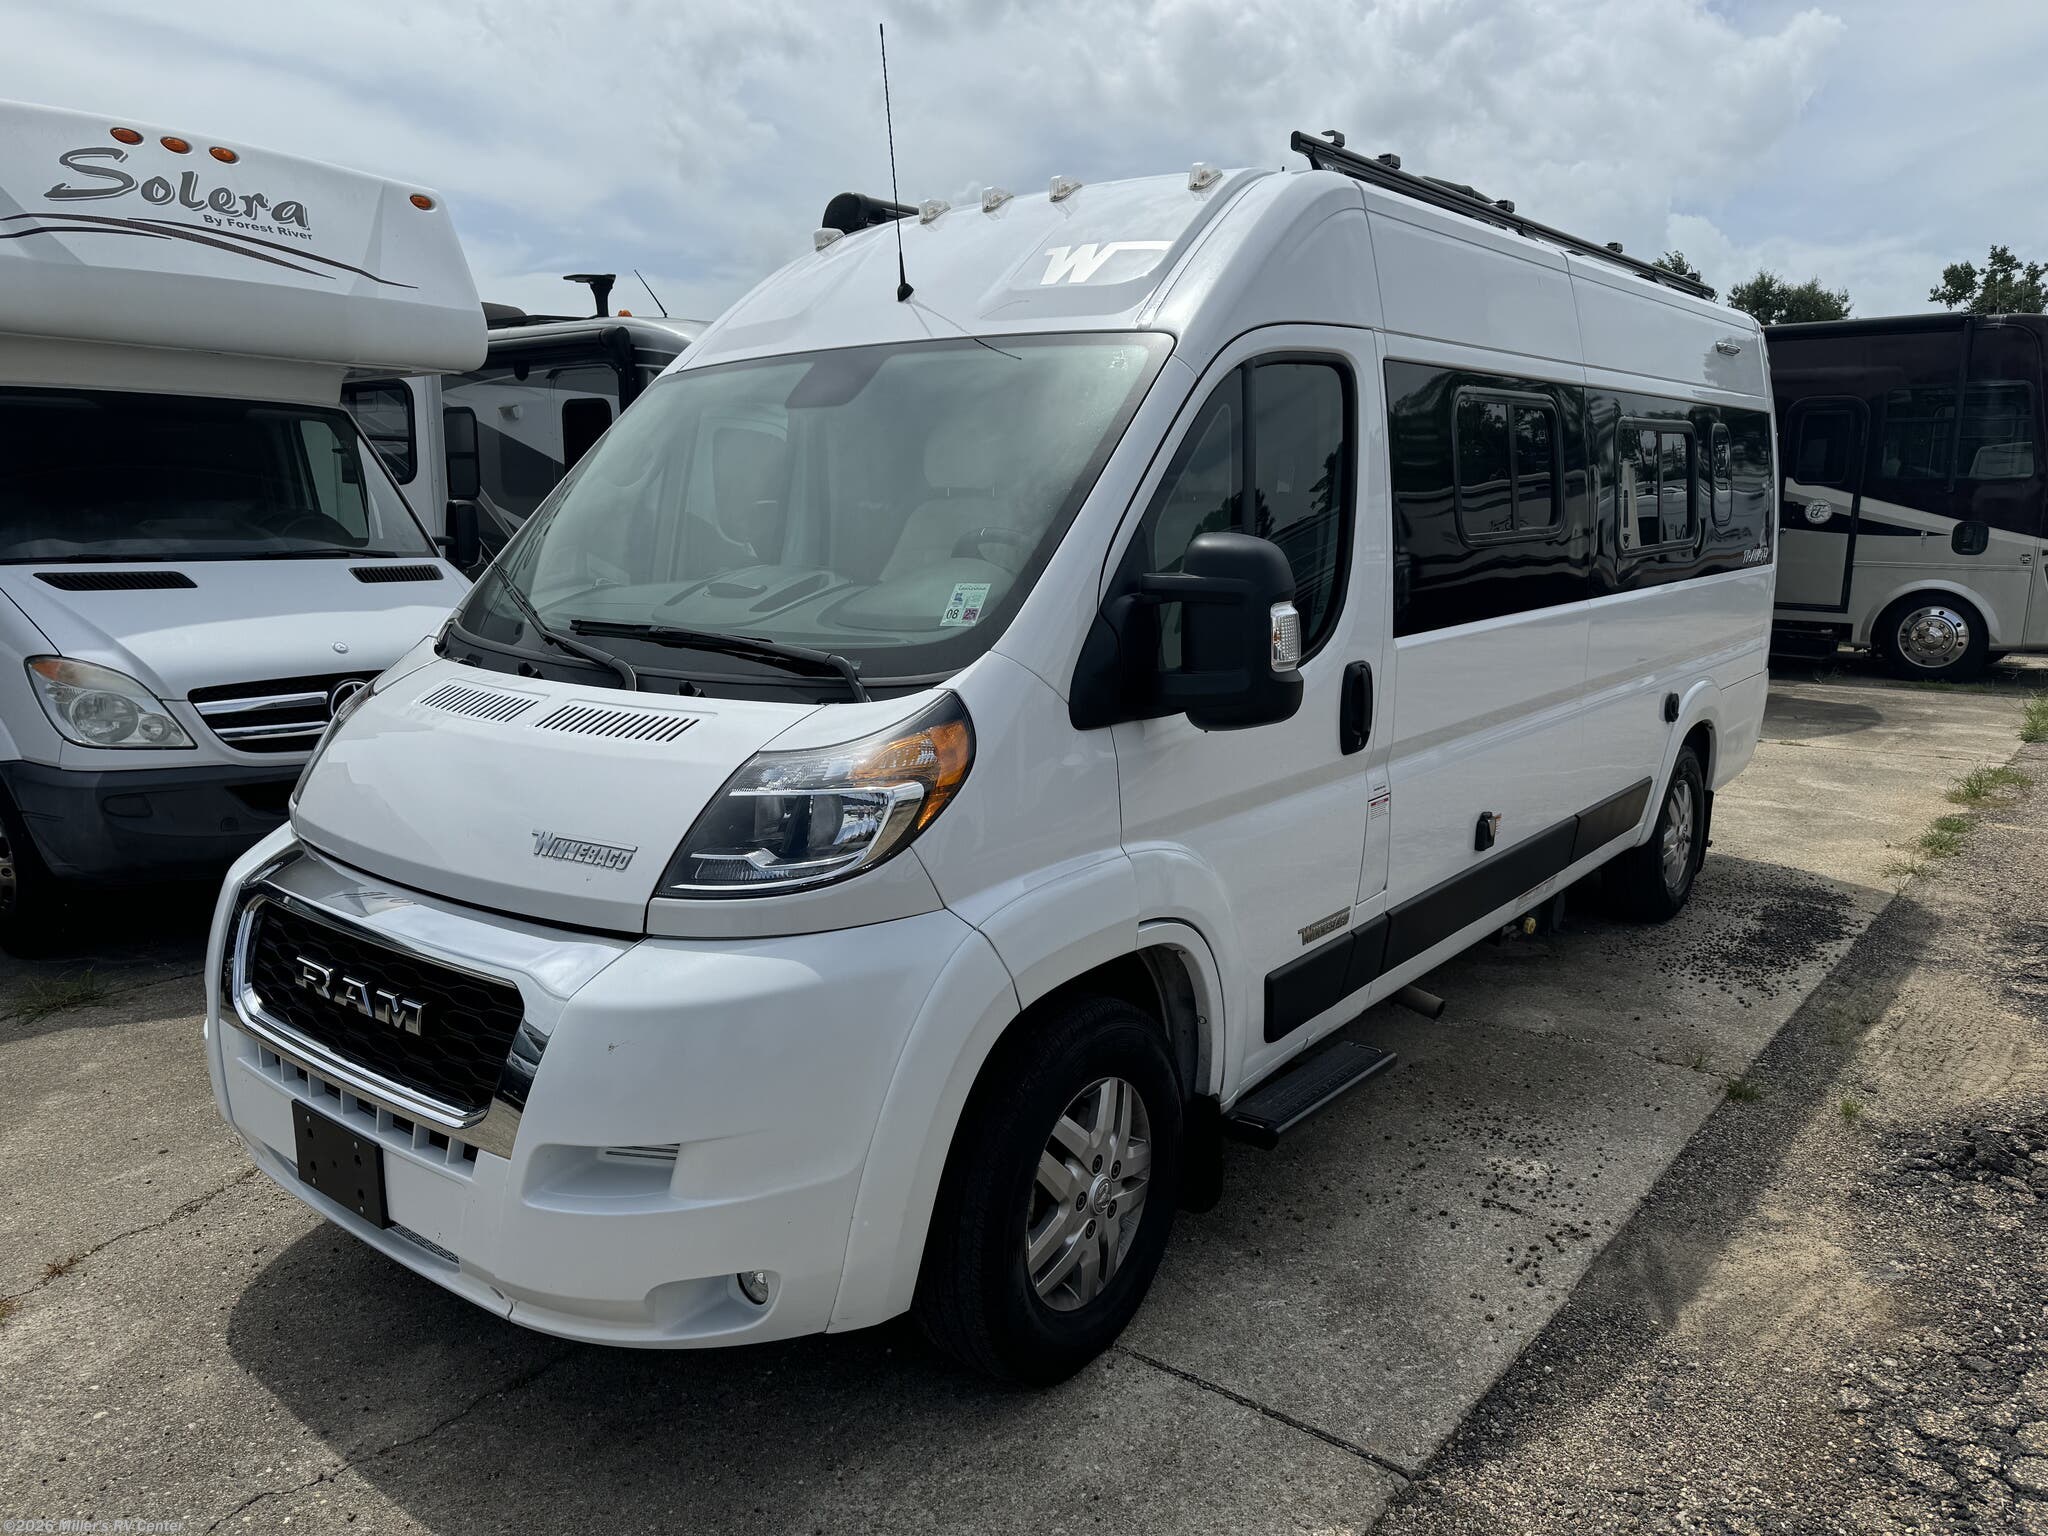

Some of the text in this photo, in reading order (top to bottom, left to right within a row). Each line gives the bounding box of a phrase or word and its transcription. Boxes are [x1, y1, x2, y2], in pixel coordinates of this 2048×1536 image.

[44, 146, 313, 231] Solera
[203, 214, 312, 240] By Forest River
[946, 608, 977, 620] 08 25
[532, 830, 638, 871] WINNEBAGO
[295, 954, 424, 1036] RAM
